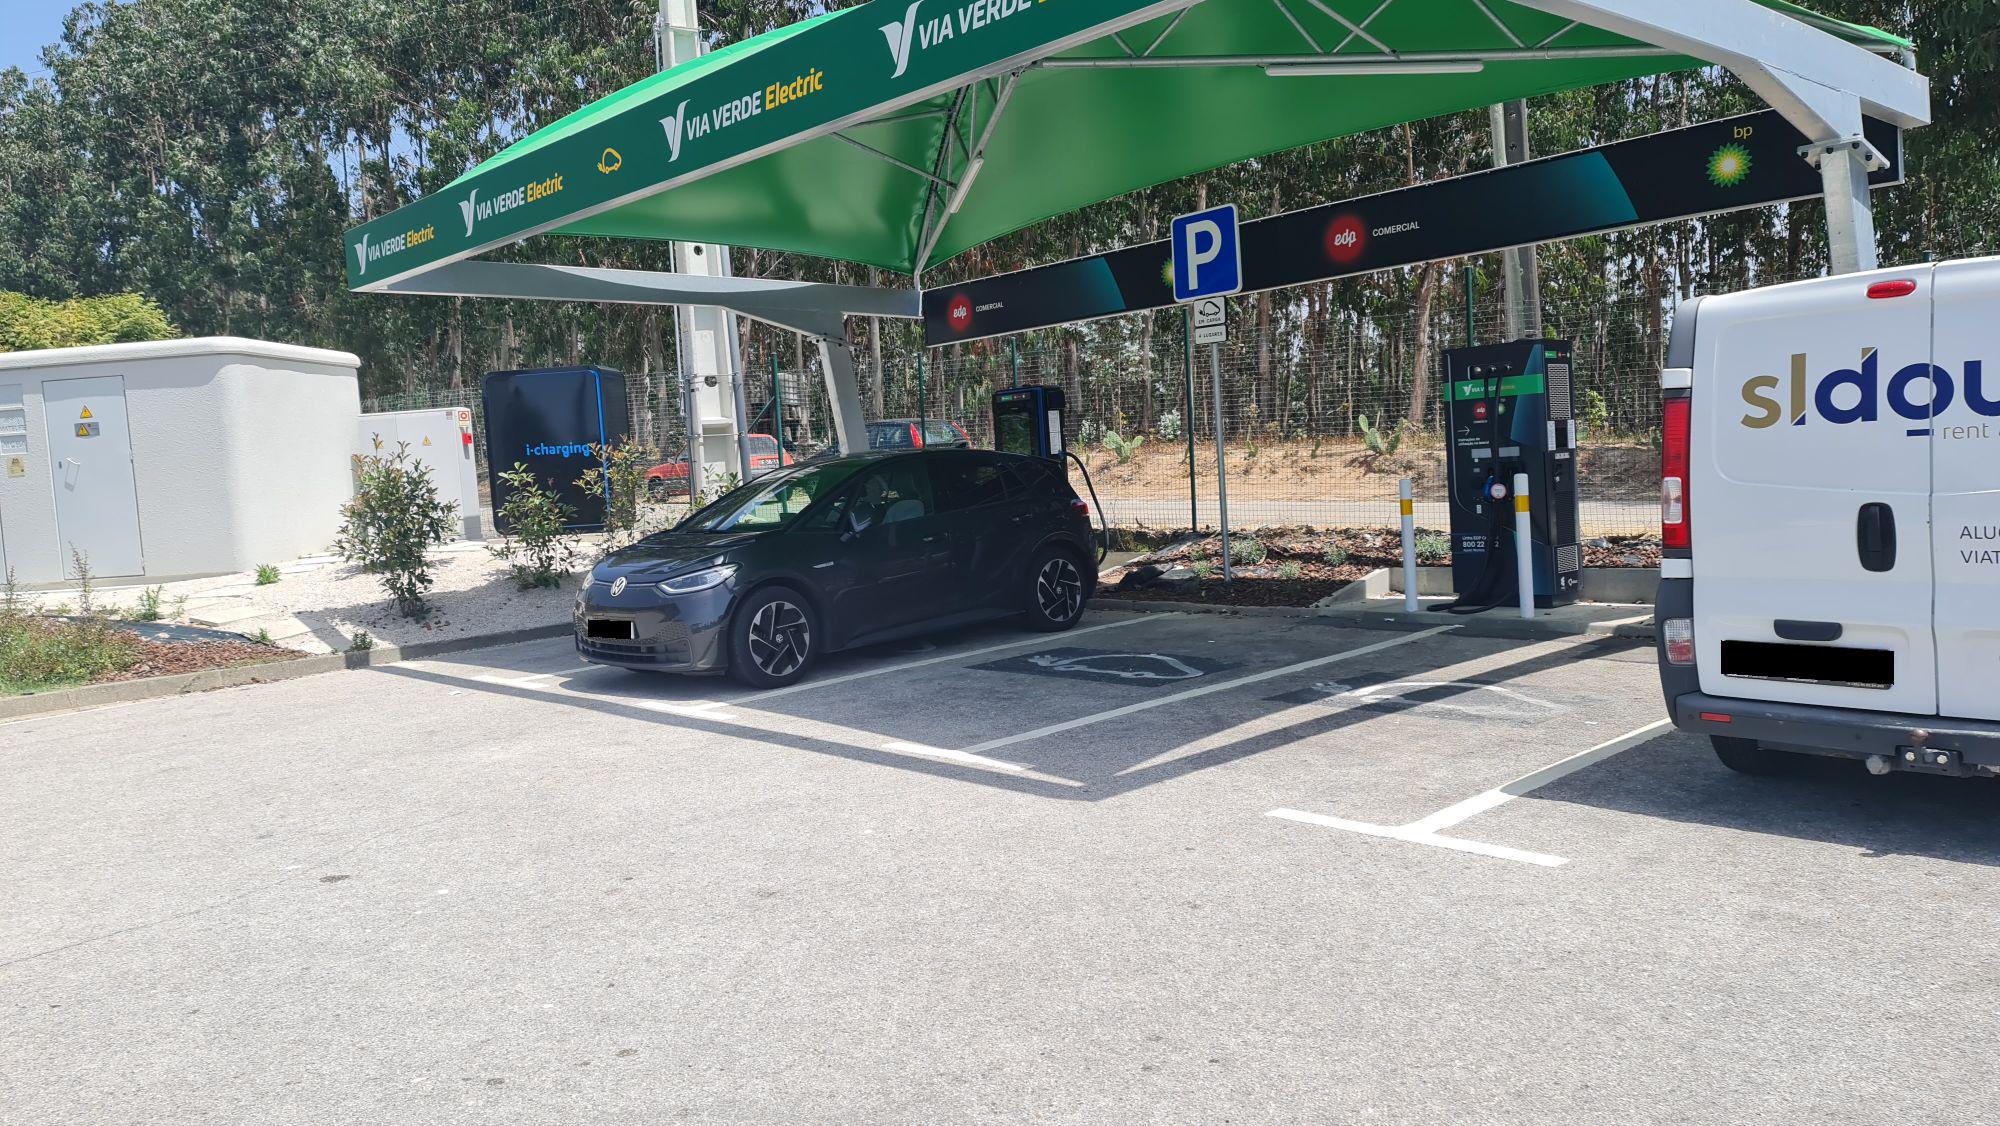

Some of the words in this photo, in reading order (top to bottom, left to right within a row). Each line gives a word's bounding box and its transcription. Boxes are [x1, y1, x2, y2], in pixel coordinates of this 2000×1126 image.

[919, 13, 953, 50] VIA
[686, 113, 710, 141] VIA
[712, 90, 762, 130] VERDE
[765, 67, 823, 111] Electric
[1733, 126, 1753, 140] bp
[476, 200, 493, 221] VIA
[493, 186, 525, 215] VERDE
[527, 172, 563, 203] Electric
[367, 243, 380, 262] VIA
[380, 233, 406, 257] VERDE
[406, 223, 435, 248] Electric
[1334, 228, 1357, 248] edp
[1372, 221, 1420, 237] COMERCIAL
[1185, 219, 1222, 291] P
[953, 305, 967, 320] edp
[975, 301, 1004, 313] COMERCIAL
[1943, 423, 1989, 440] rent
[526, 441, 590, 458] i-charging
[1960, 525, 2000, 539] ALU
